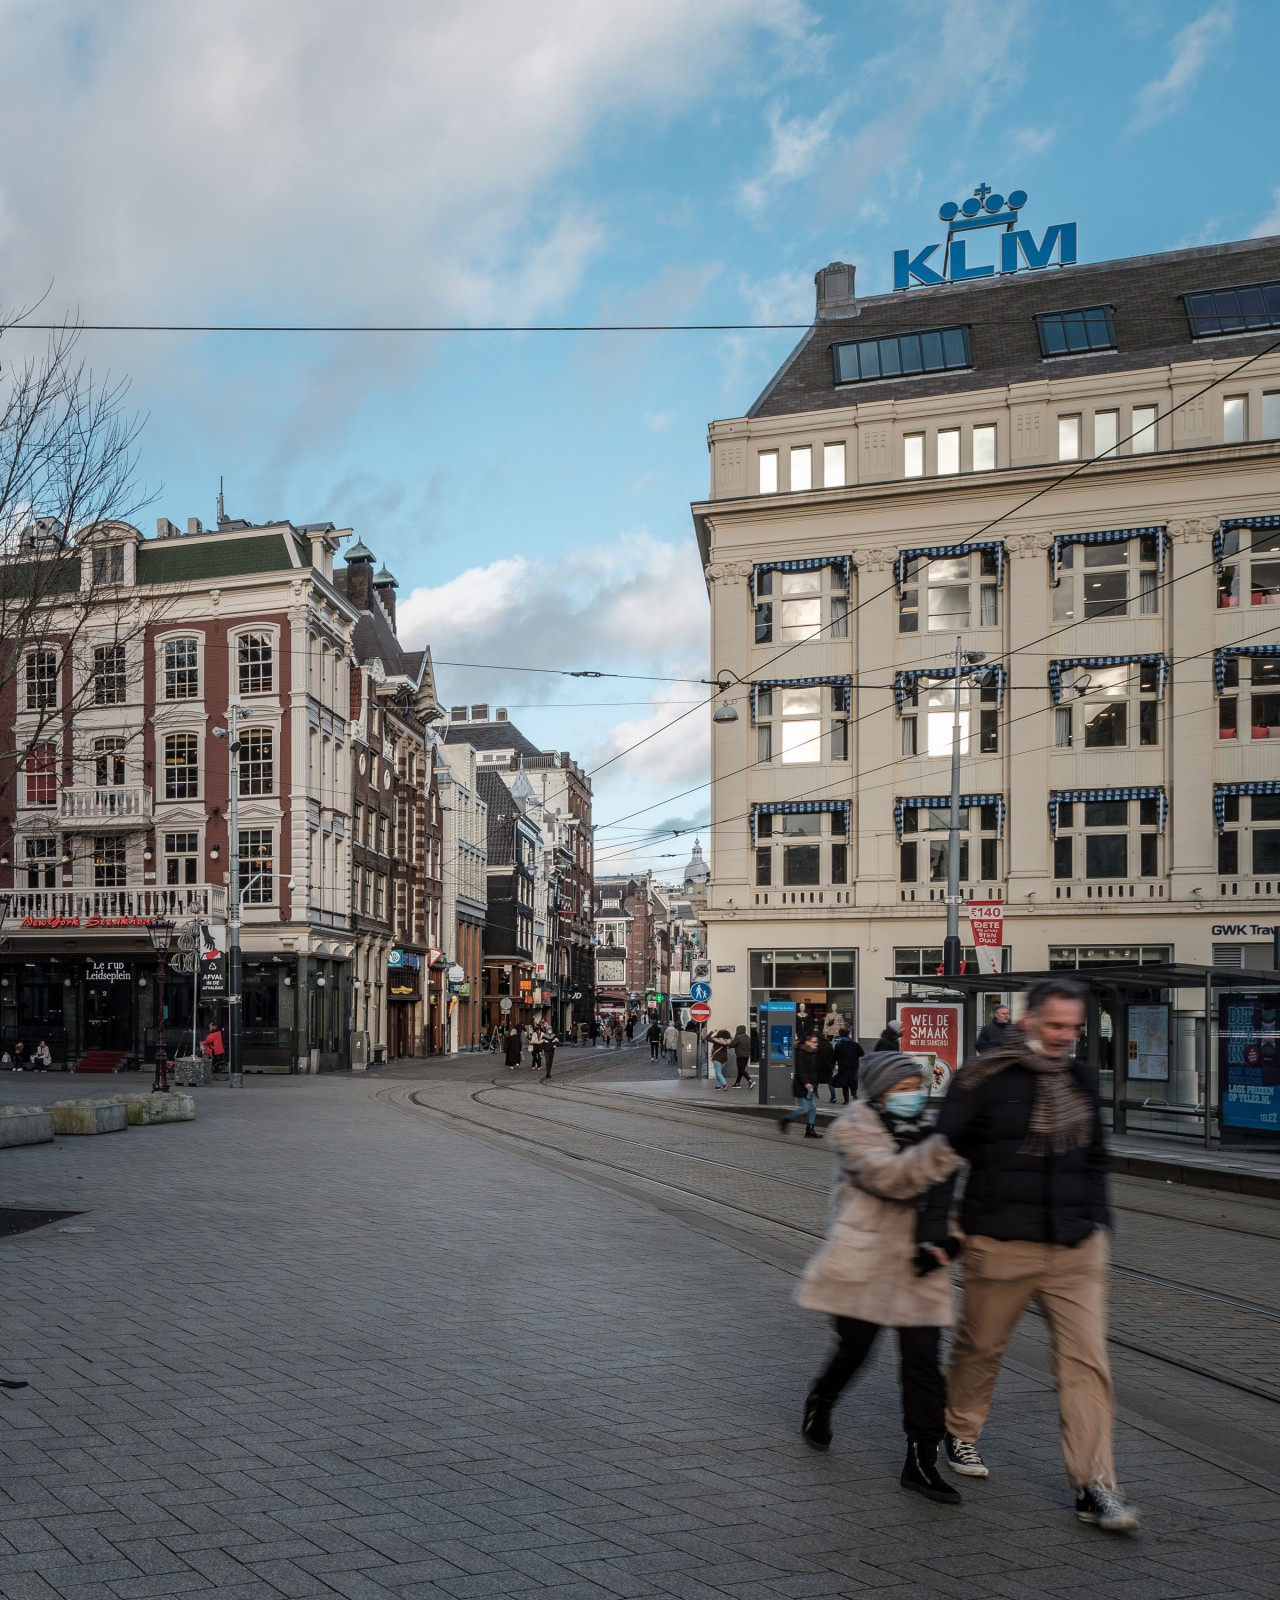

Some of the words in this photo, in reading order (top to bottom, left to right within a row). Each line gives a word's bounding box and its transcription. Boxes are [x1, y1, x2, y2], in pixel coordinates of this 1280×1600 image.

[893, 222, 1077, 291] KLM
[971, 907, 1001, 917] €140
[20, 916, 47, 929] New
[1211, 924, 1248, 936] GWK
[86, 970, 131, 984] Leidseplein
[910, 1014, 933, 1026] WEL
[937, 1014, 949, 1026] DE
[1228, 1006, 1254, 1025] DIT
[910, 1026, 948, 1039] SMAAK
[1228, 1045, 1245, 1063] IK
[1228, 1085, 1246, 1093] LAGE
[1228, 1093, 1238, 1102] OP
[1239, 1094, 1271, 1104] TELE2.NL
[1260, 1113, 1277, 1123] TELE2
